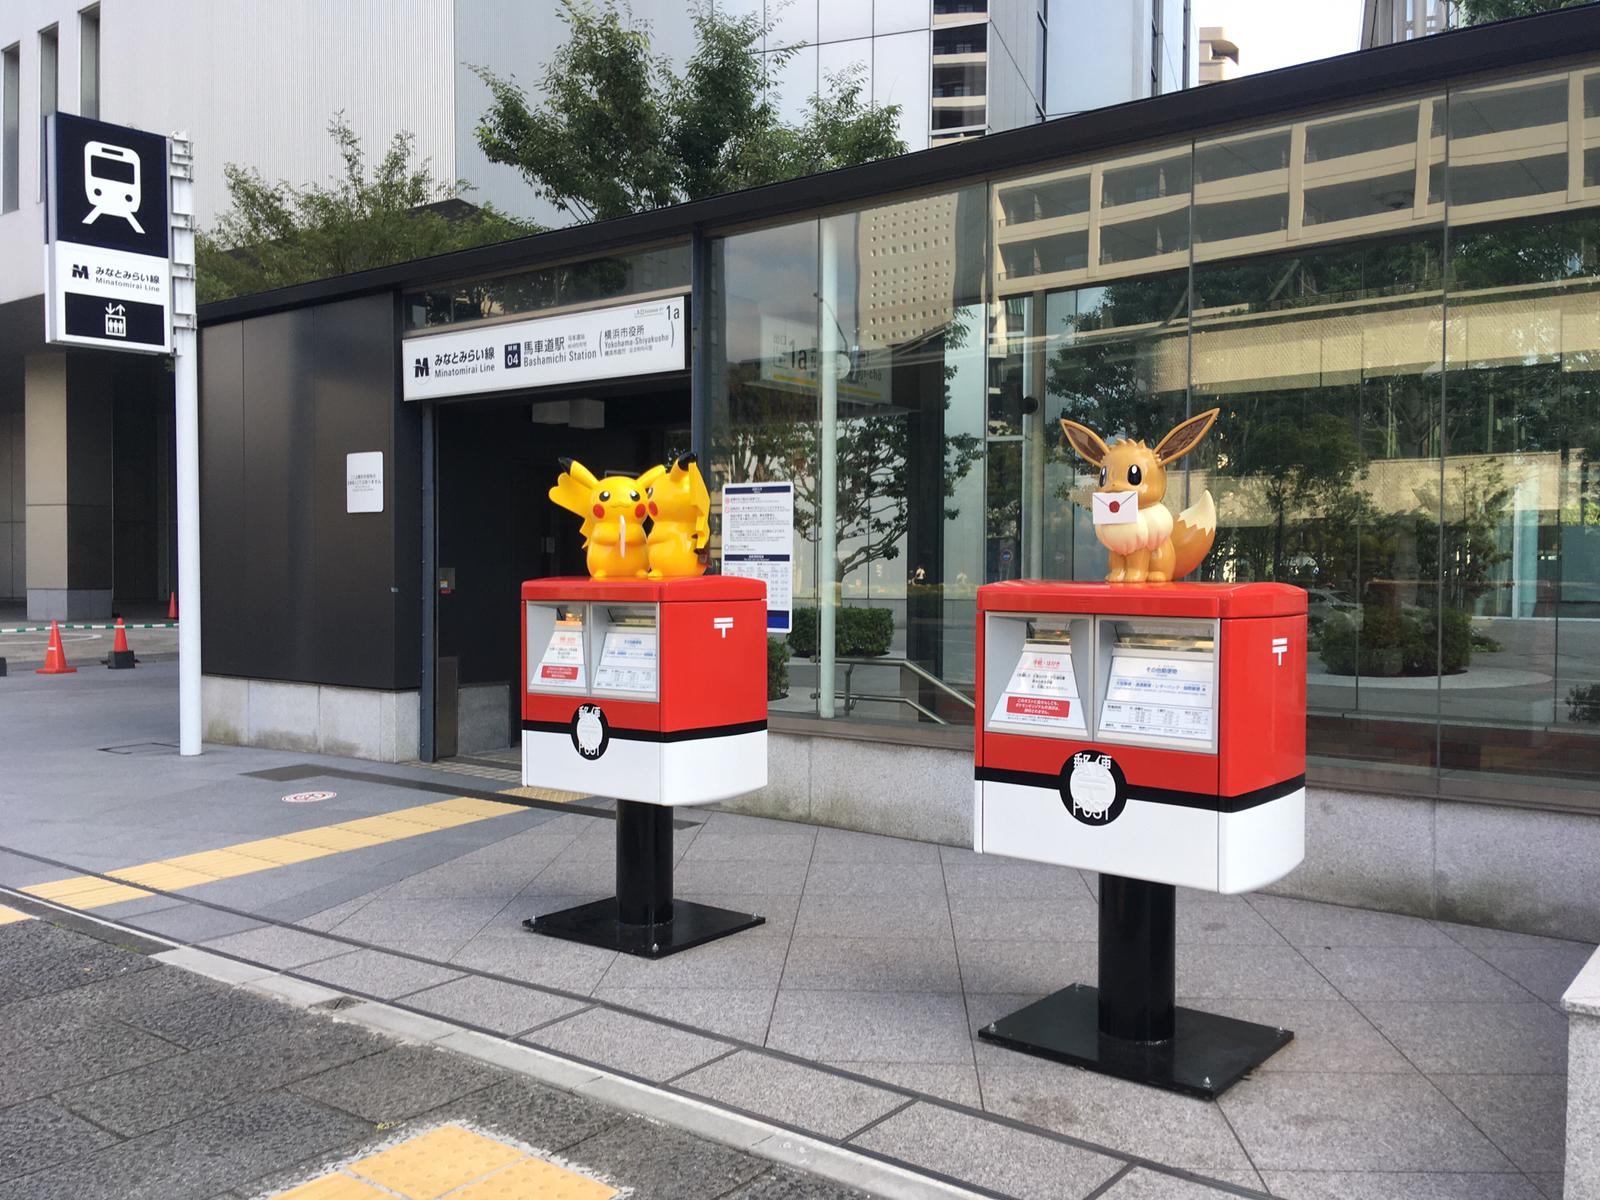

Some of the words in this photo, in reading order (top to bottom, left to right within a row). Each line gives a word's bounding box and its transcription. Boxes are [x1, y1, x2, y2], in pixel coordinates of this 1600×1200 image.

[95, 266, 160, 284] みなとみらい線
[95, 277, 142, 290] Minatomirai
[144, 284, 160, 292] Line
[666, 304, 680, 321] 1a
[604, 324, 645, 339] 横浜市役所
[523, 336, 565, 355] 馬車道駅
[788, 338, 807, 370] 1a
[434, 346, 496, 366] みなとみらい線
[506, 353, 519, 366] 04
[523, 352, 567, 367] Bashamichi
[568, 350, 597, 362] Station
[434, 364, 478, 378] Minatomirai
[479, 363, 496, 372] Line
